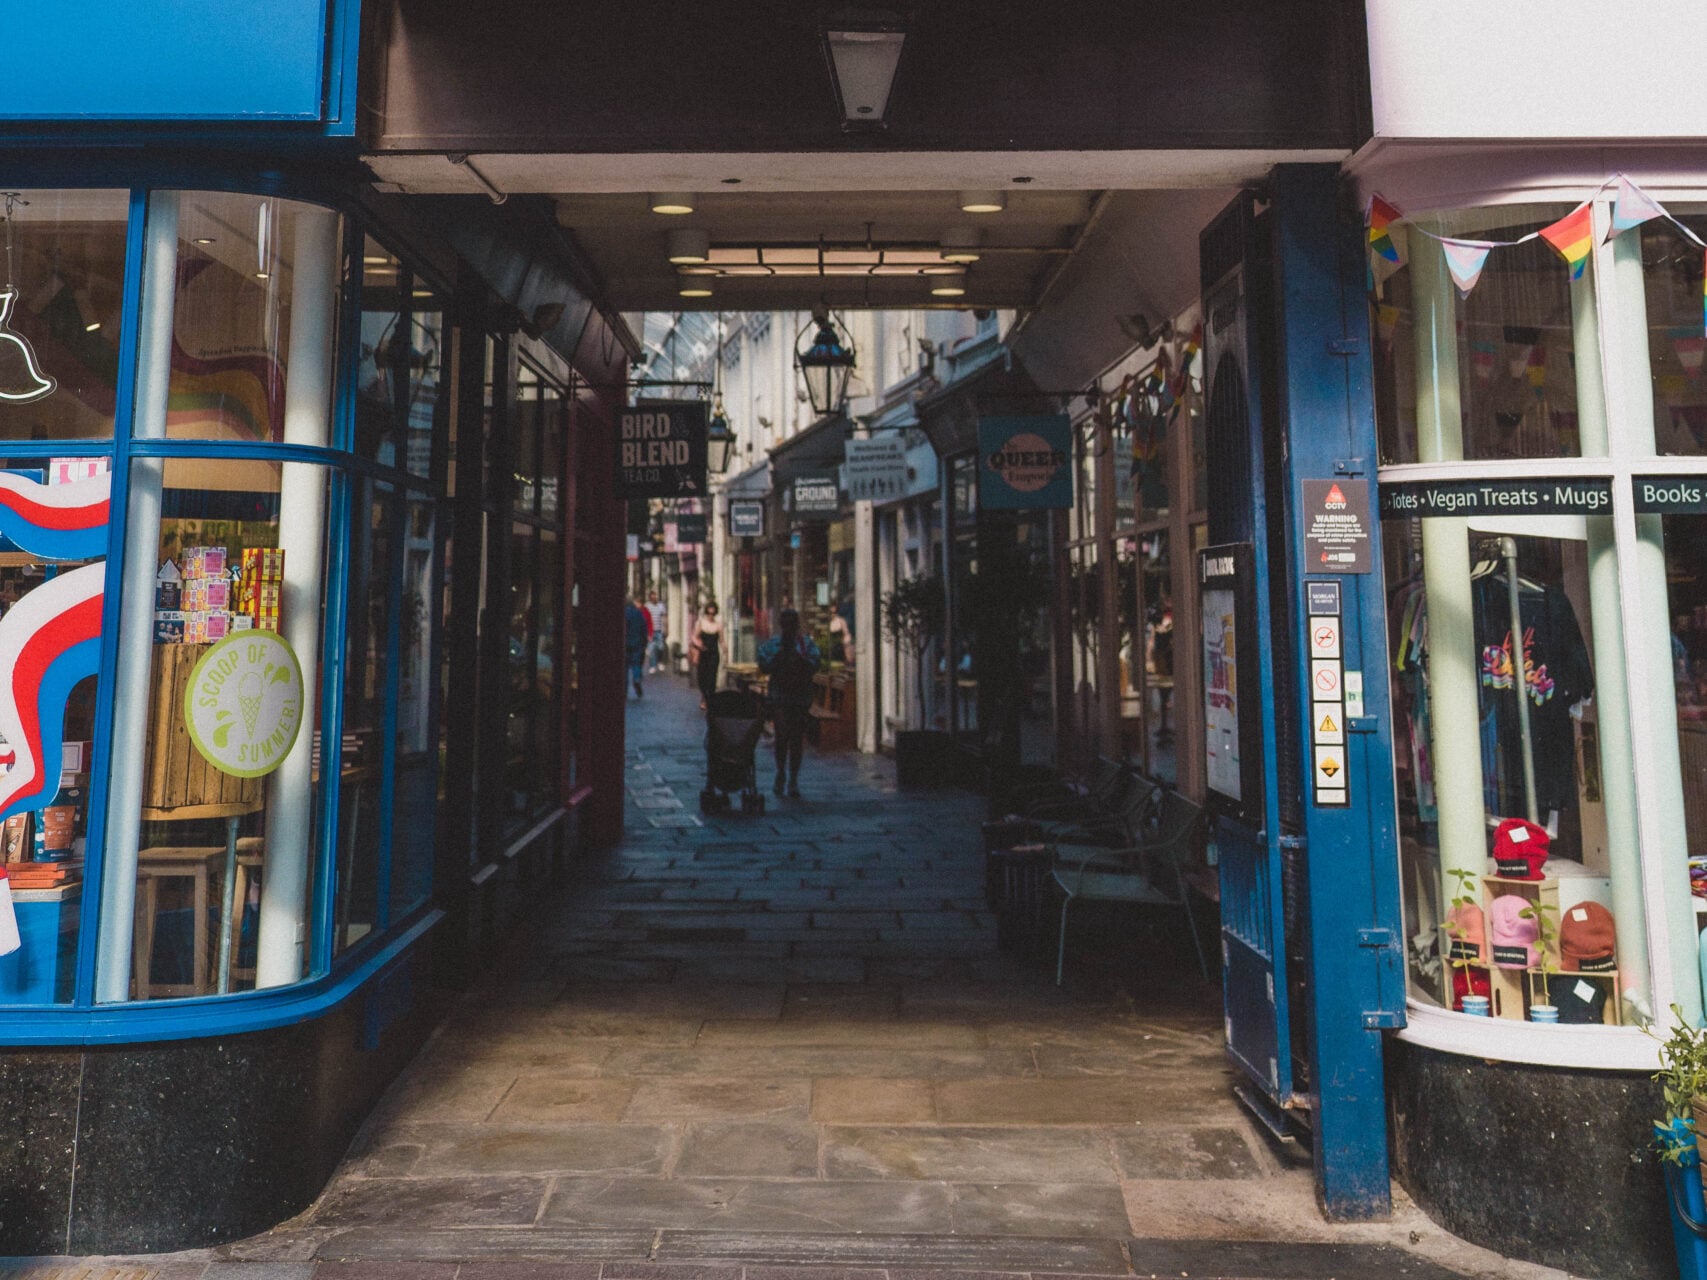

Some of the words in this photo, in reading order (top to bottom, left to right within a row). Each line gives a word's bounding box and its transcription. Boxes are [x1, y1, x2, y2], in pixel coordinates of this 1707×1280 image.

[622, 413, 670, 439] BIRD
[622, 440, 689, 467] BLEND
[990, 450, 1065, 470] QUEER
[795, 485, 837, 501] GROUND
[1391, 492, 1418, 510] Totes
[1427, 489, 1477, 511] Vegan
[1480, 487, 1538, 507] Treats
[1555, 486, 1608, 509] Mugs
[1644, 483, 1701, 503] Books
[1325, 502, 1347, 510] CCTV
[1315, 514, 1357, 523] WARNING
[199, 650, 239, 708] SCOOP
[247, 643, 269, 664] OF
